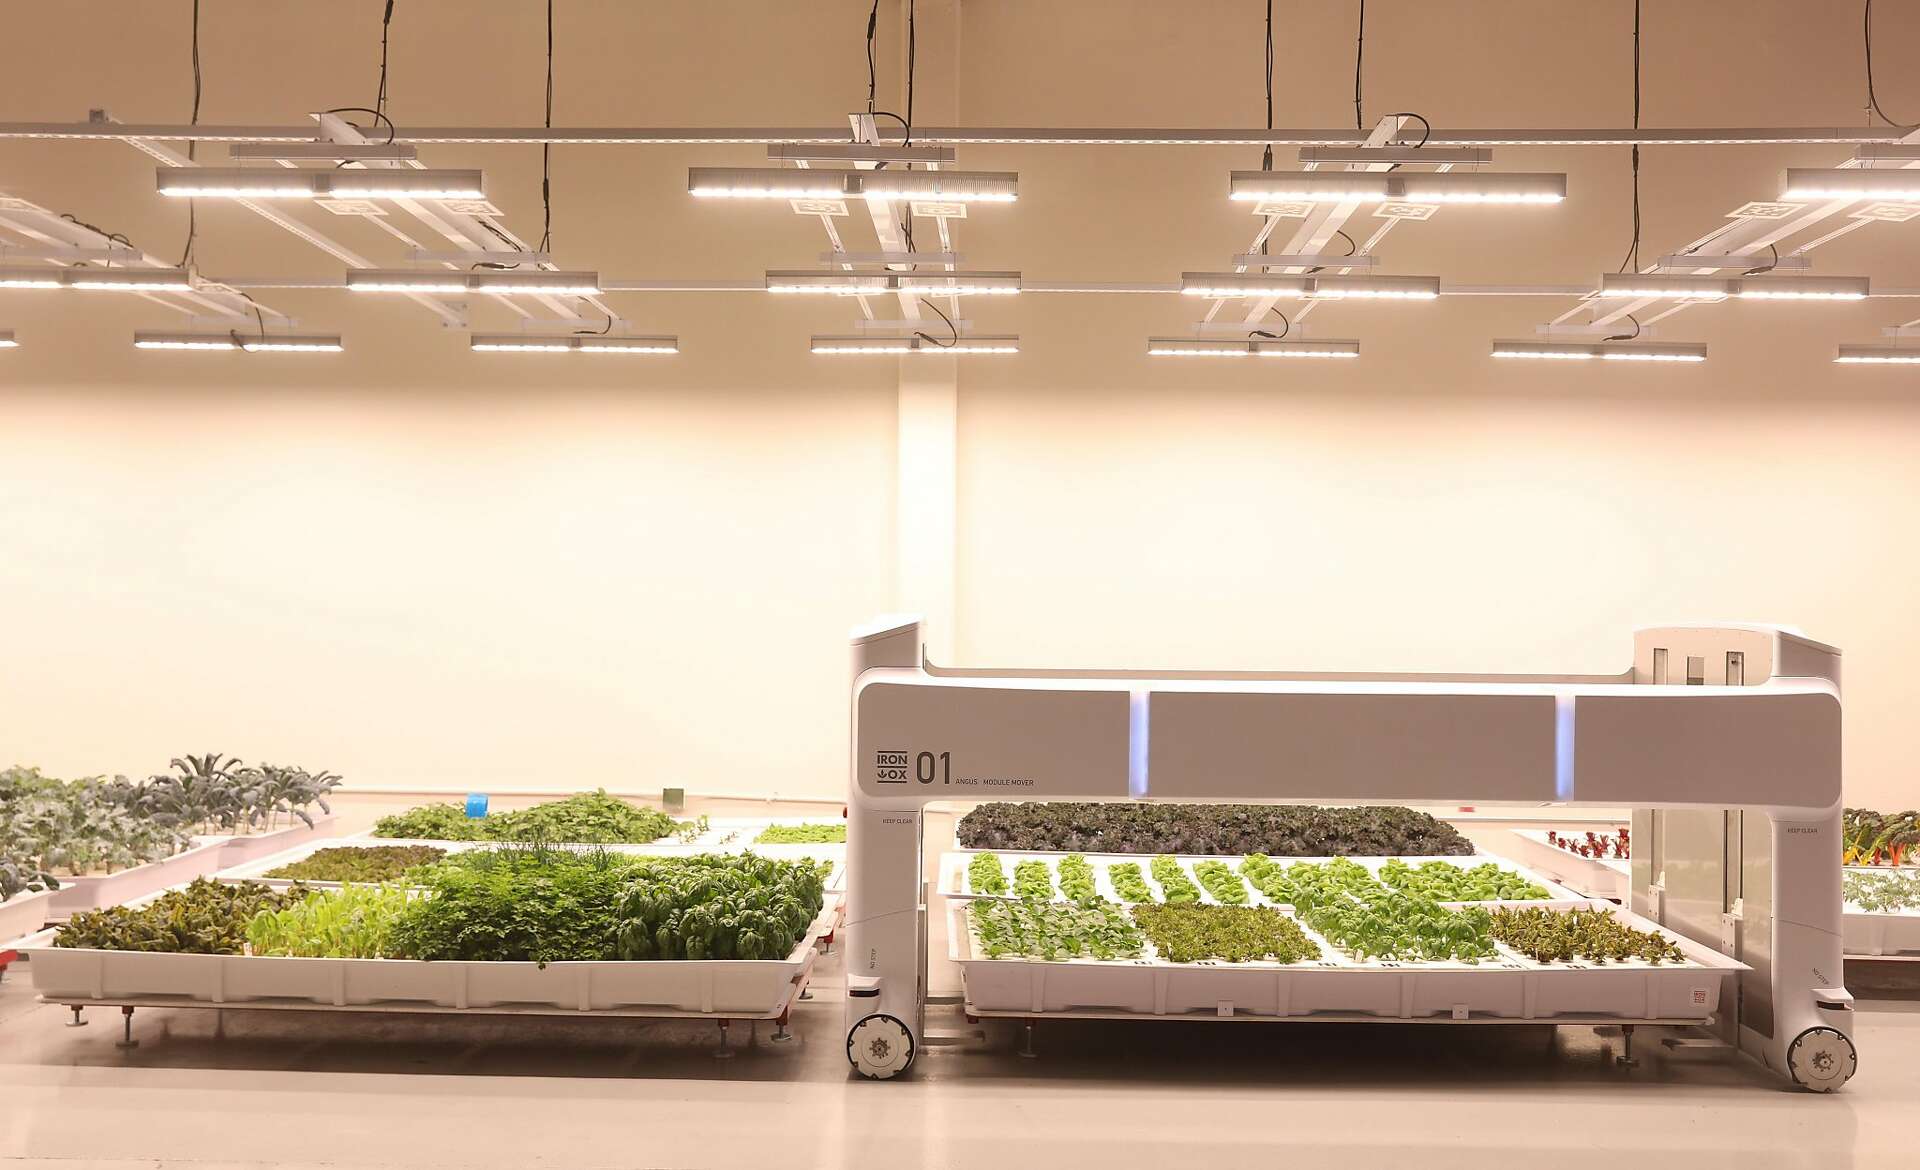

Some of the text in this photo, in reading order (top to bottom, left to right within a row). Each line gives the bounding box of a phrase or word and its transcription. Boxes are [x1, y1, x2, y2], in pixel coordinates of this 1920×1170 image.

[877, 754, 908, 765] IRON
[916, 751, 951, 785] 01
[888, 769, 907, 780] OX
